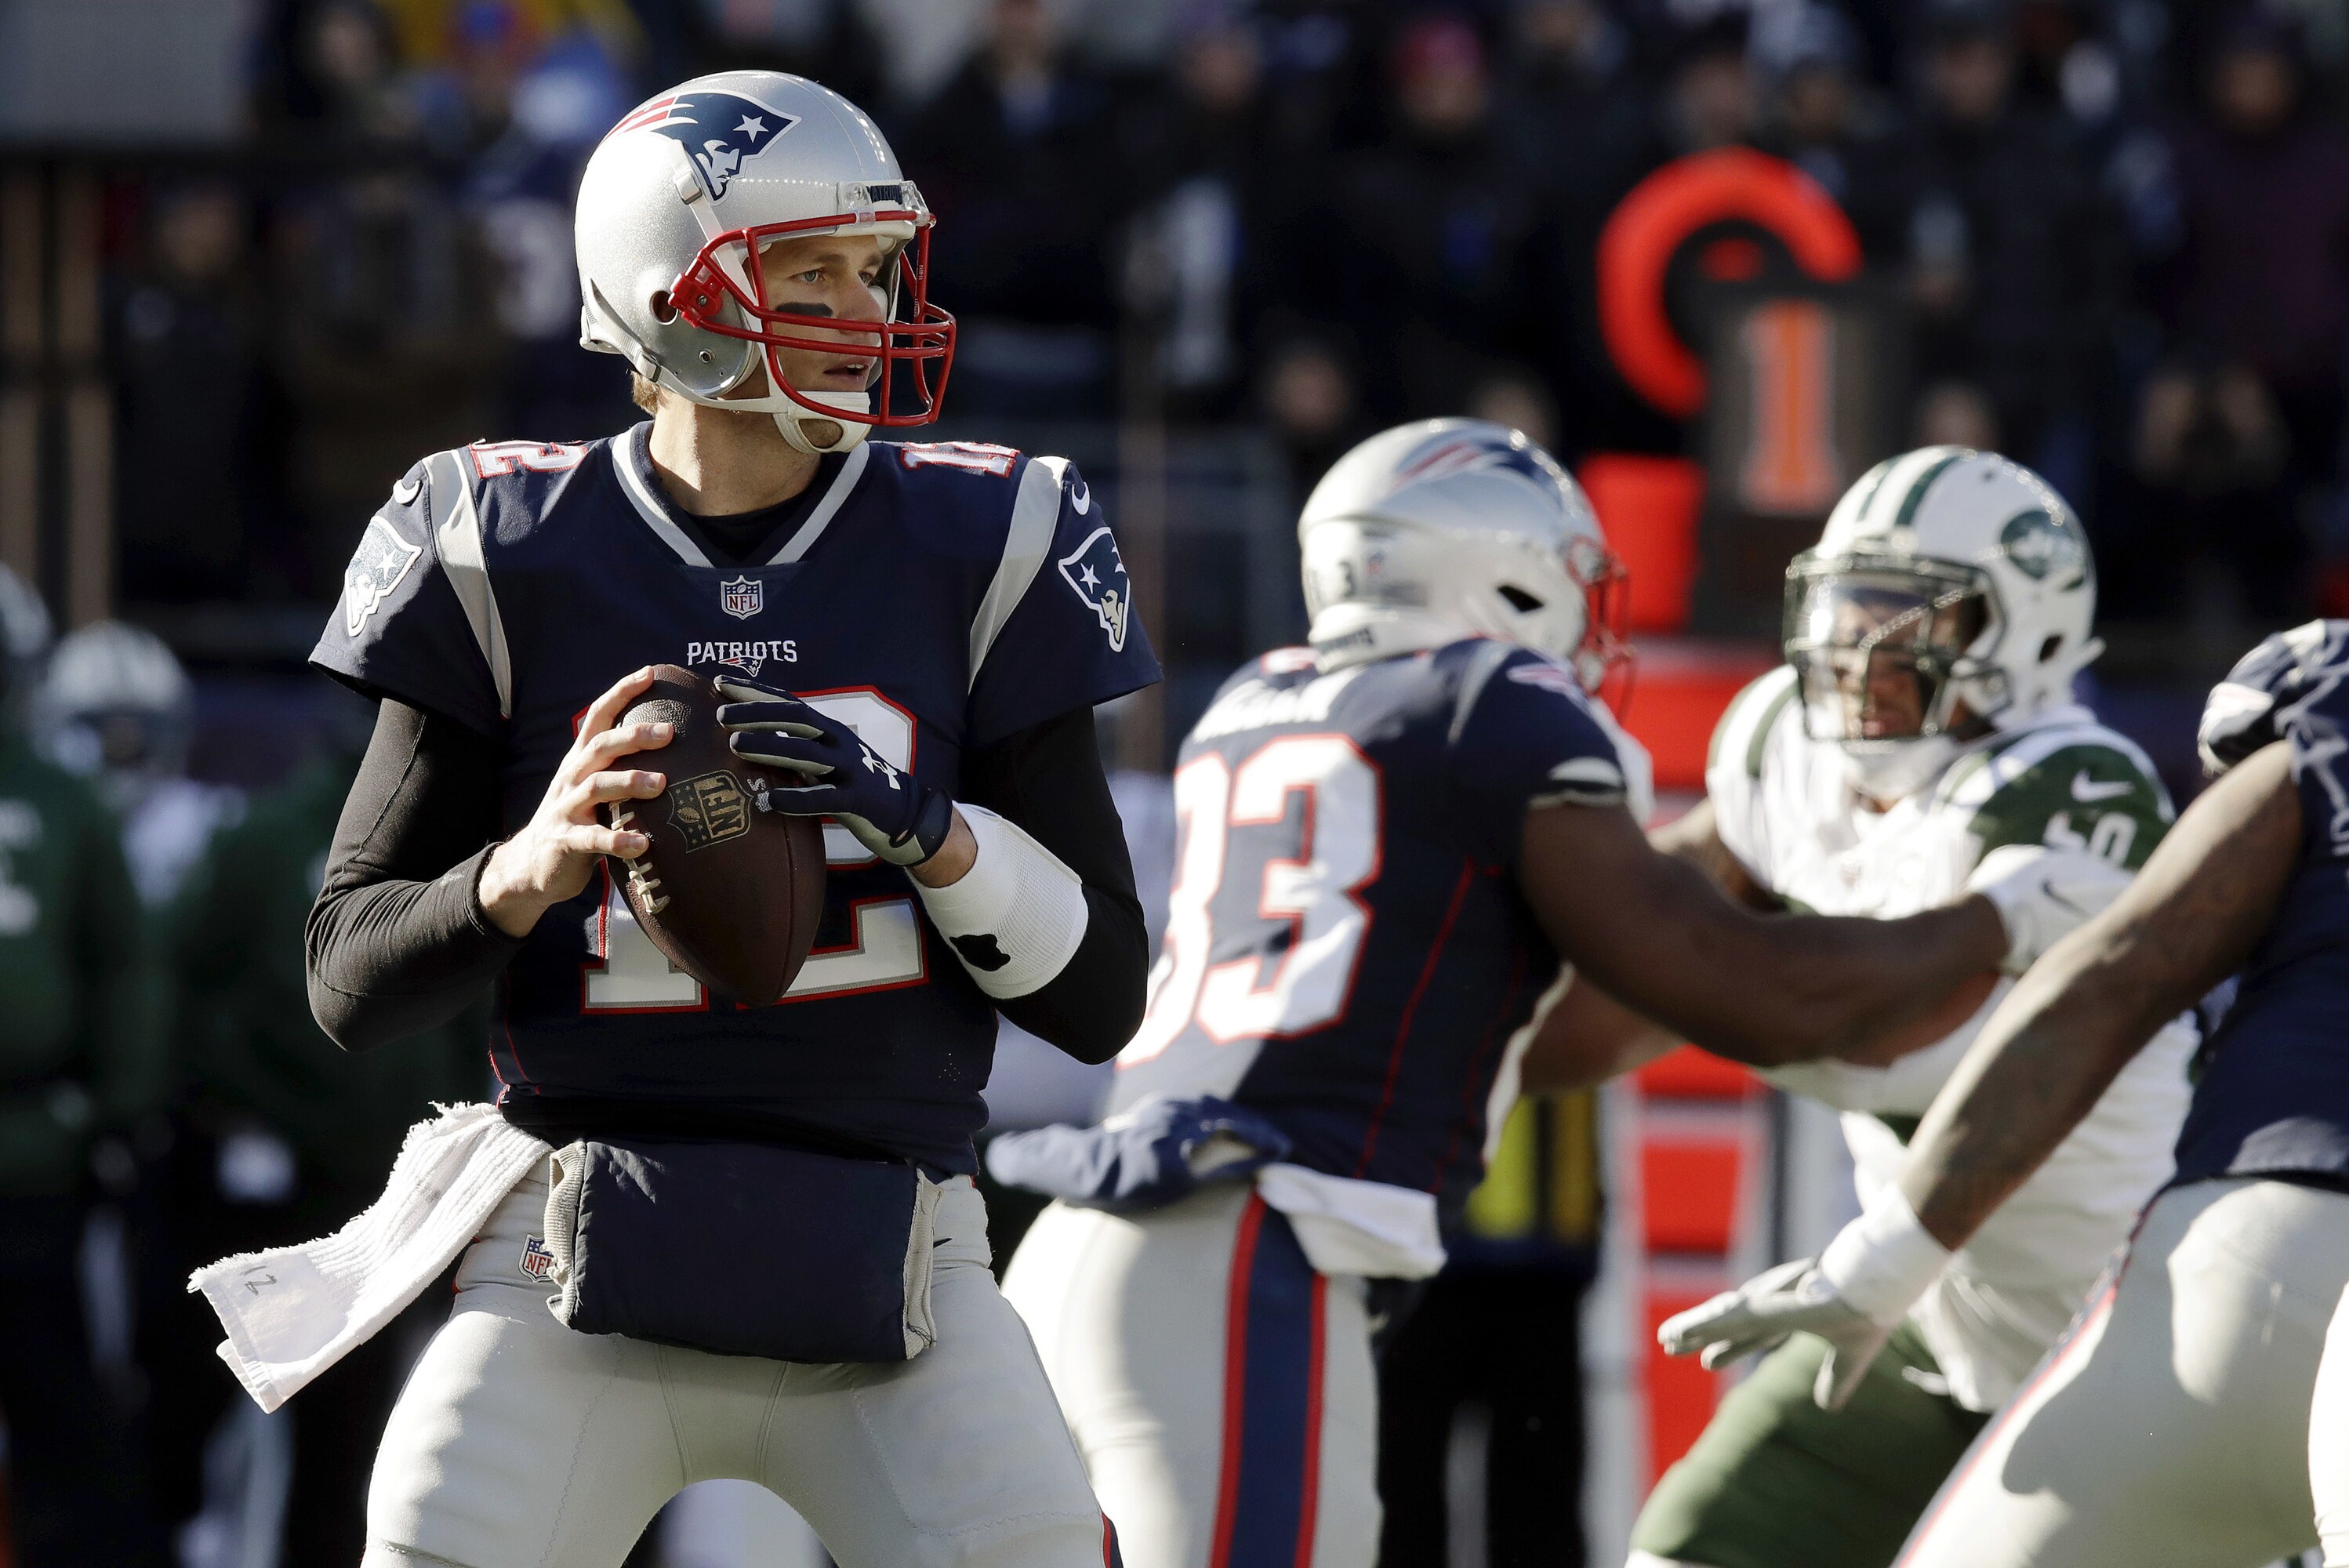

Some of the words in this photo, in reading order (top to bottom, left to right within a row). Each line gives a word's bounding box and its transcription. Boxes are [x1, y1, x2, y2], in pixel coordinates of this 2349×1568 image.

[469, 439, 588, 479] 2
[900, 441, 1020, 479] 1
[728, 596, 757, 611] NFL
[687, 640, 797, 666] PATRIOTS
[700, 776, 742, 836] NFL
[238, 1265, 277, 1295] 12
